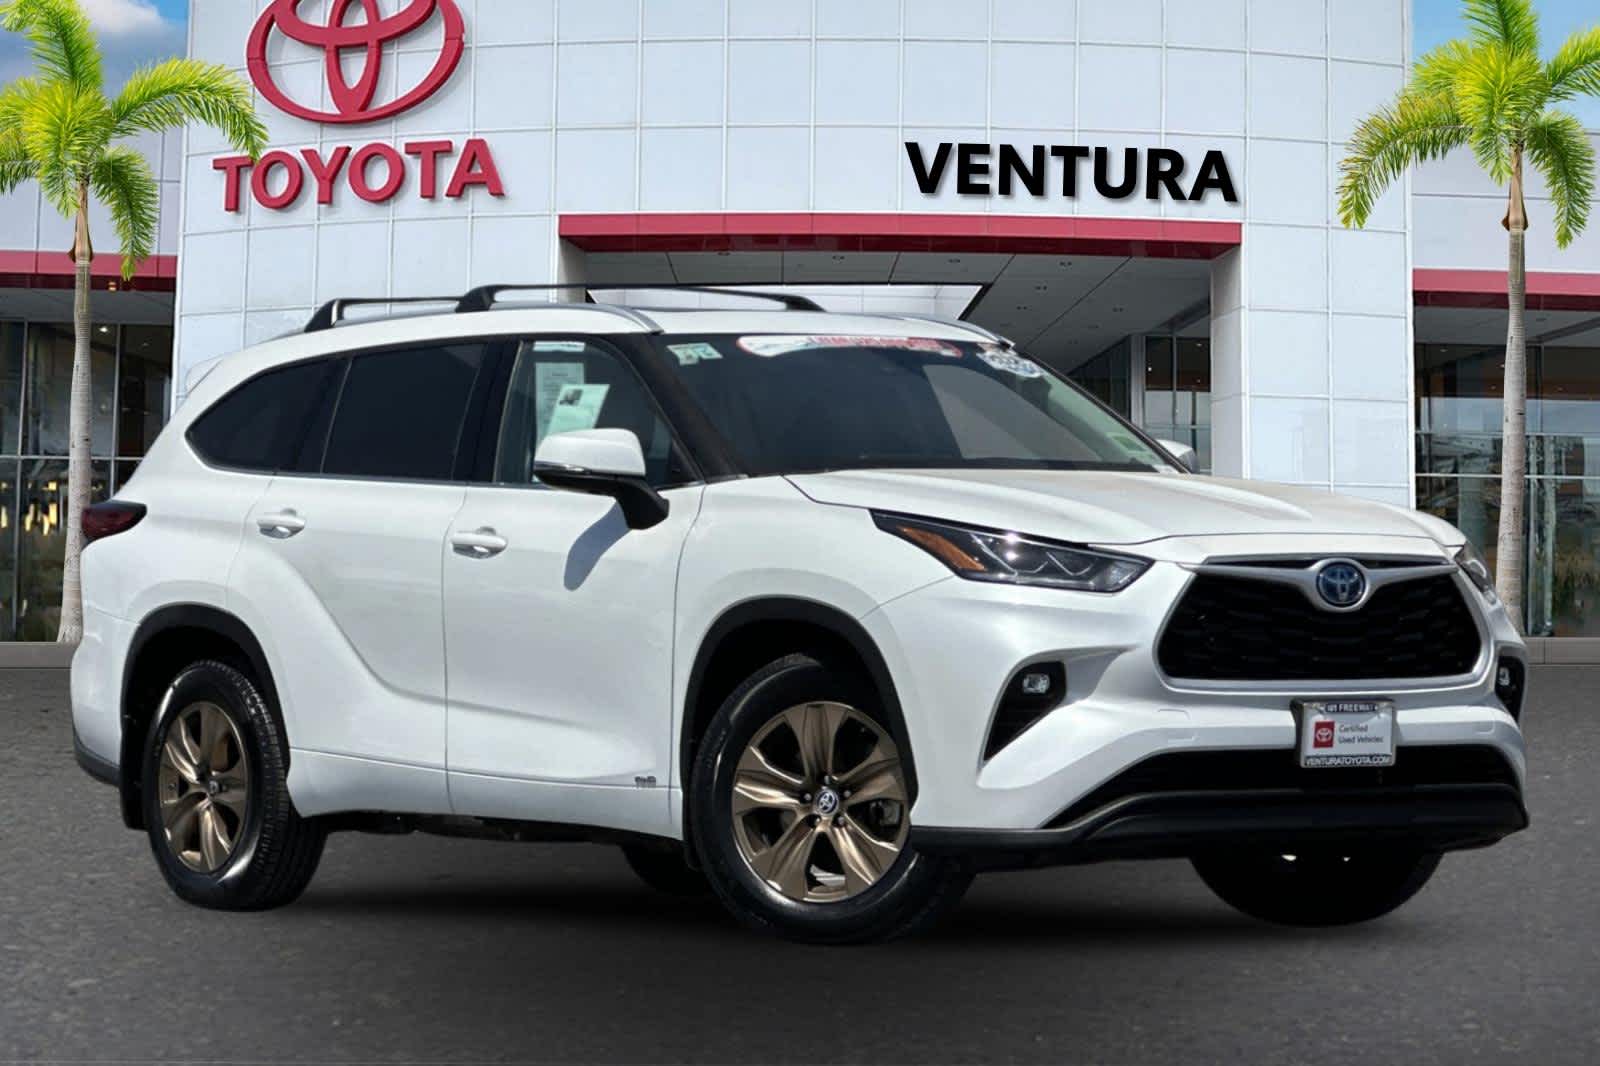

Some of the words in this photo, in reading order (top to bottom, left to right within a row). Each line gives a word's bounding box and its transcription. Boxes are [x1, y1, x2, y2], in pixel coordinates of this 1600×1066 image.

[212, 138, 505, 212] TOYOTA
[904, 141, 1240, 203] VENTURA
[1339, 724, 1368, 732] Certified
[1339, 735, 1356, 744] Used
[1357, 735, 1384, 743] Vehicles
[1307, 755, 1390, 766] VENTURATOYOTA.COM
